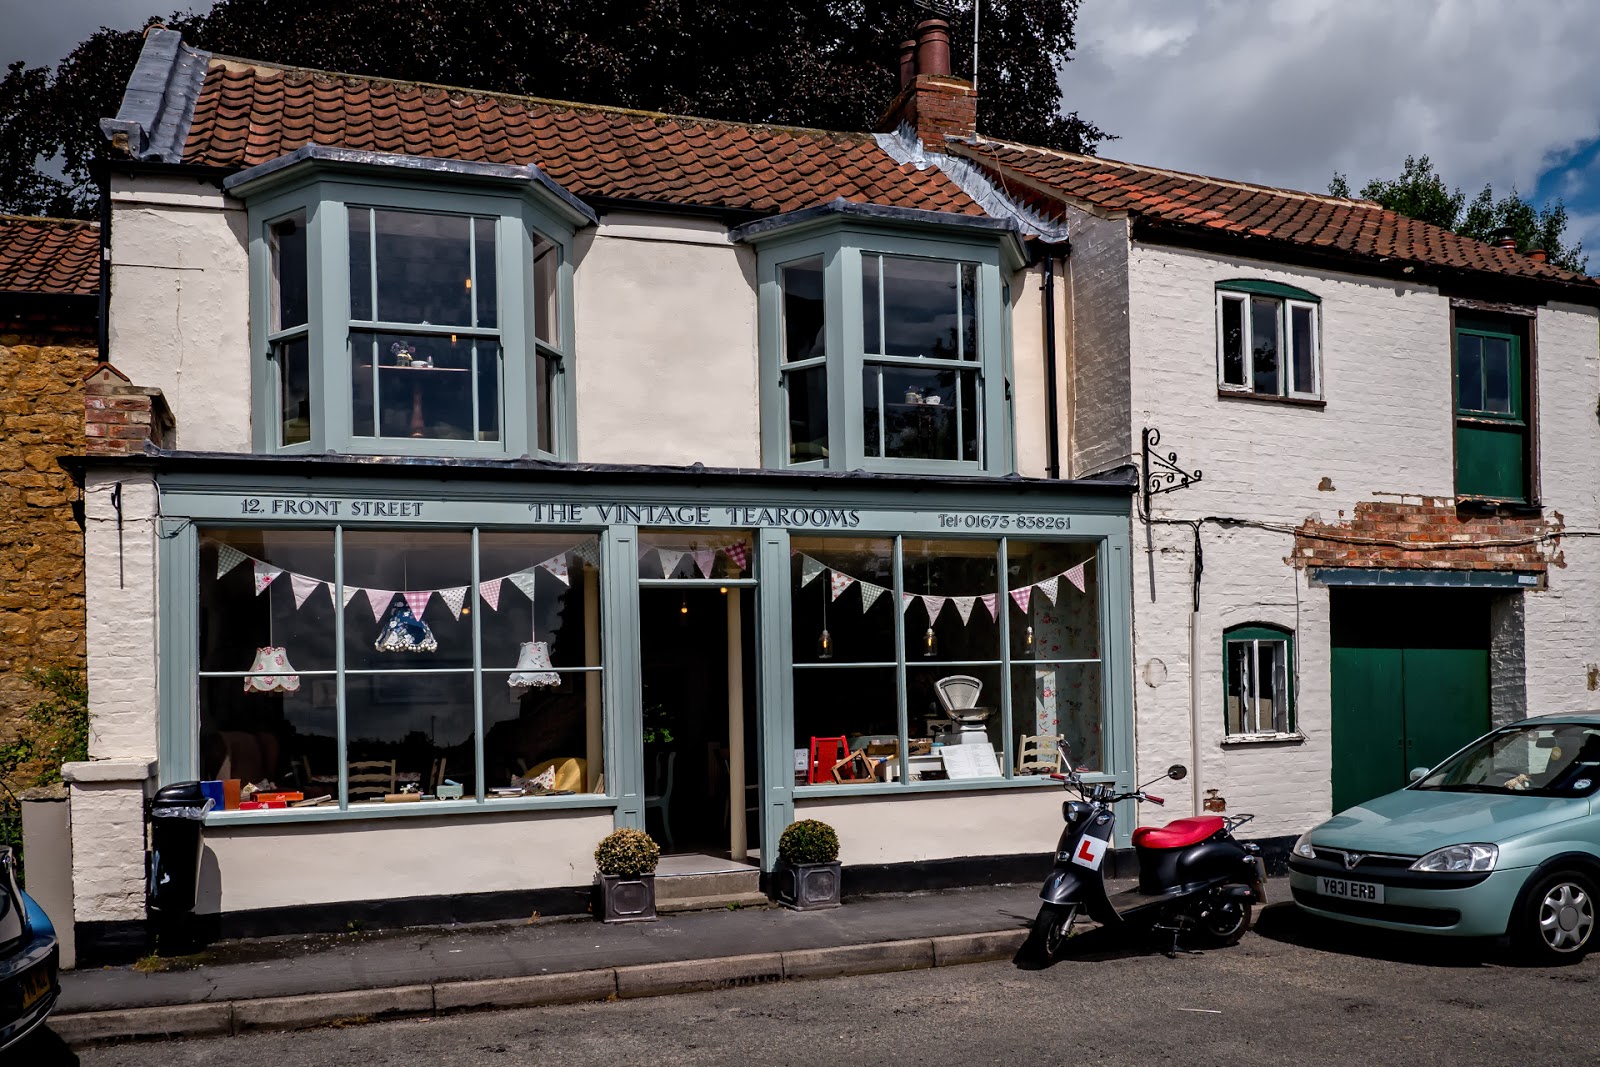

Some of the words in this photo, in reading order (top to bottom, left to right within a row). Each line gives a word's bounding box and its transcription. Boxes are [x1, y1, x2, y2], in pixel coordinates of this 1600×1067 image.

[272, 500, 342, 515] FRONT
[351, 501, 424, 516] STREET
[528, 503, 583, 523] THE
[595, 503, 711, 525] VINTAGE
[726, 507, 860, 527] TEAROOMS
[1078, 840, 1095, 862] L
[1323, 879, 1348, 896] Y831
[1350, 882, 1376, 900] ERB
